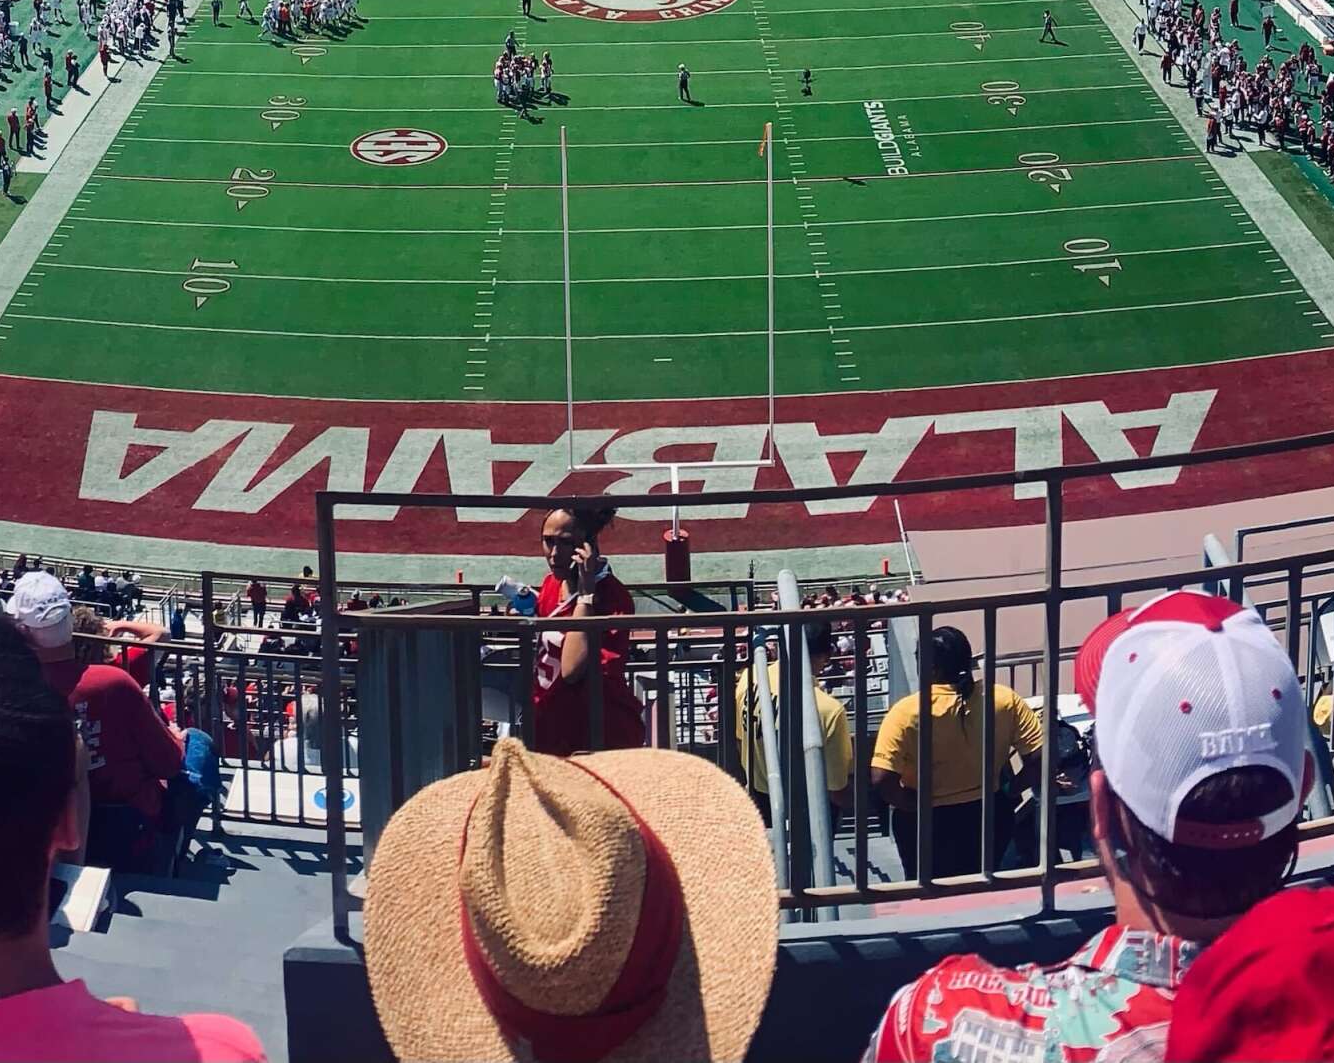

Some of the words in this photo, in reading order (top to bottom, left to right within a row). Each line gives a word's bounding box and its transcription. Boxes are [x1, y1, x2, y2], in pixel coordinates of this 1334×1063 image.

[949, 21, 993, 40] 40
[260, 94, 307, 122] 30
[981, 81, 1027, 106] 30
[863, 100, 909, 176] BUILDGIANTS
[897, 114, 923, 158] ALABAMA
[226, 167, 277, 199] 20
[1018, 152, 1073, 182] 20
[1063, 238, 1123, 273] 10
[182, 257, 240, 294] 10
[78, 389, 1219, 523] ALABAMA
